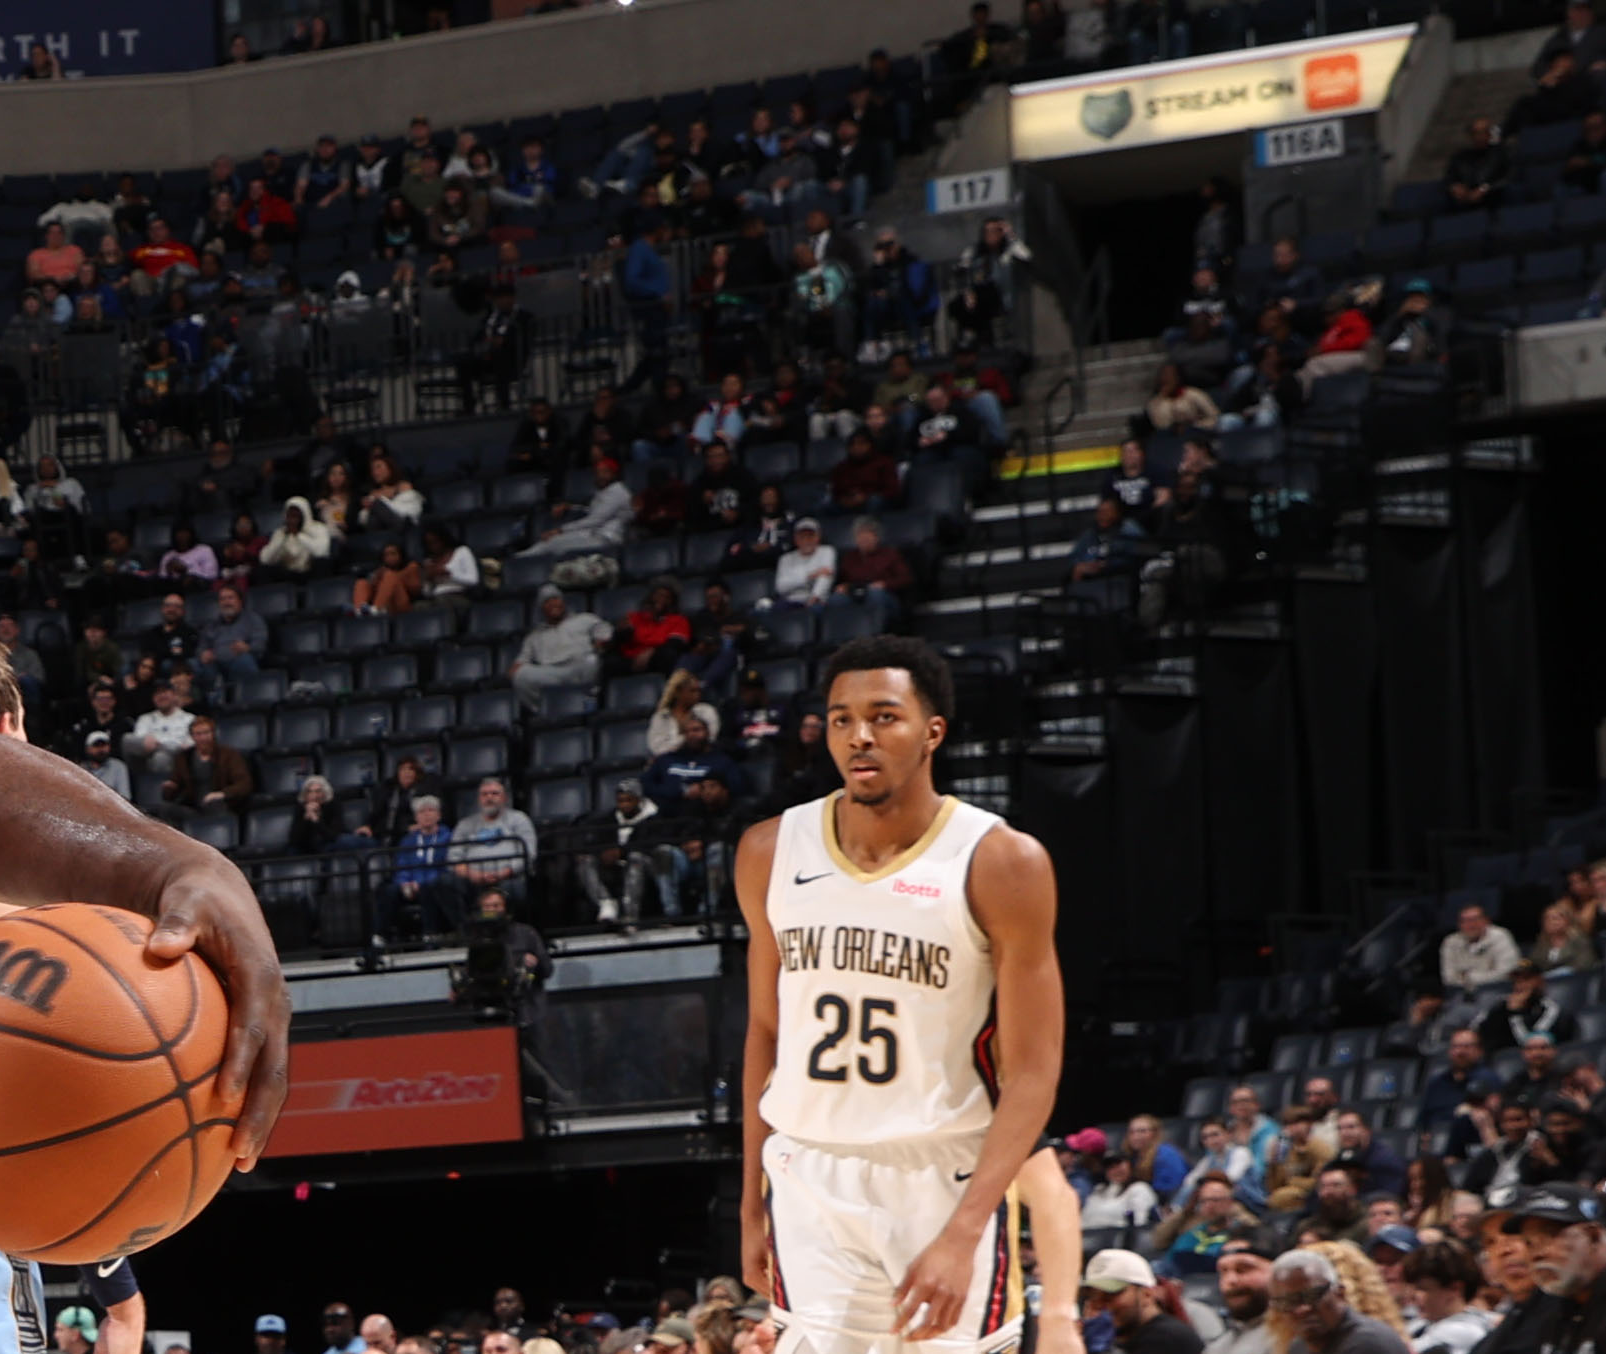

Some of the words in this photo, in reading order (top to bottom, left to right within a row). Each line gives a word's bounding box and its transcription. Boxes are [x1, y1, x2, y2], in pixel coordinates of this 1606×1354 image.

[99, 29, 142, 57] IT
[1144, 86, 1248, 119] STREAM
[1258, 78, 1294, 101] ON
[950, 176, 994, 206] 117
[891, 878, 942, 899] ibotta
[832, 925, 951, 990] ORLEANS
[806, 993, 900, 1086] 25
